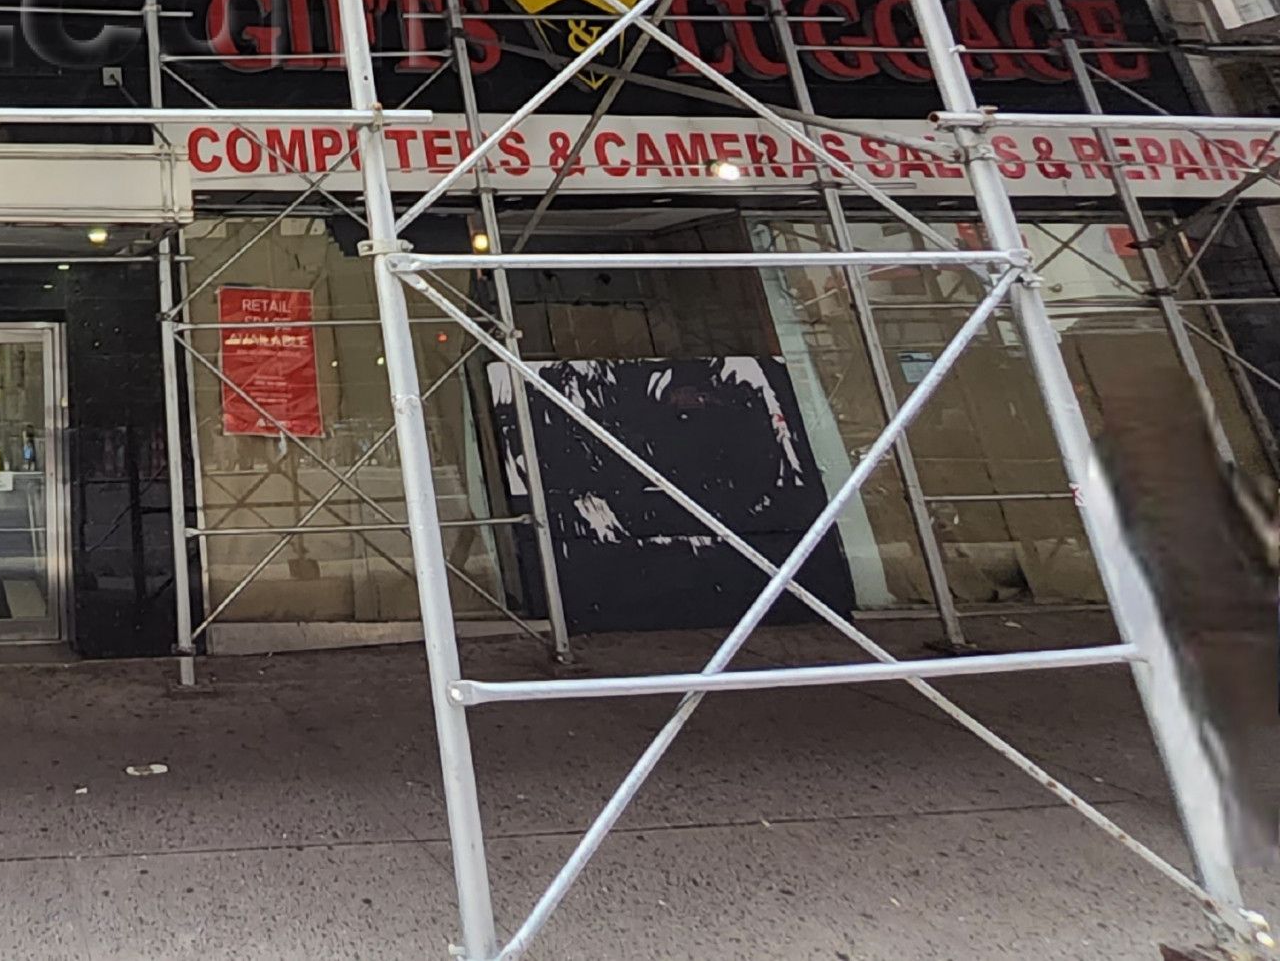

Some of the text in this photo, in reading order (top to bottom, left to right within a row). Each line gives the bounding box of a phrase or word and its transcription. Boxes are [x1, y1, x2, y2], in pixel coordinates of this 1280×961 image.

[548, 131, 586, 178] &
[594, 132, 856, 179] CAMERAS
[860, 136, 1027, 180] SALS
[1032, 136, 1072, 180] &
[242, 298, 292, 314] RETAIL
